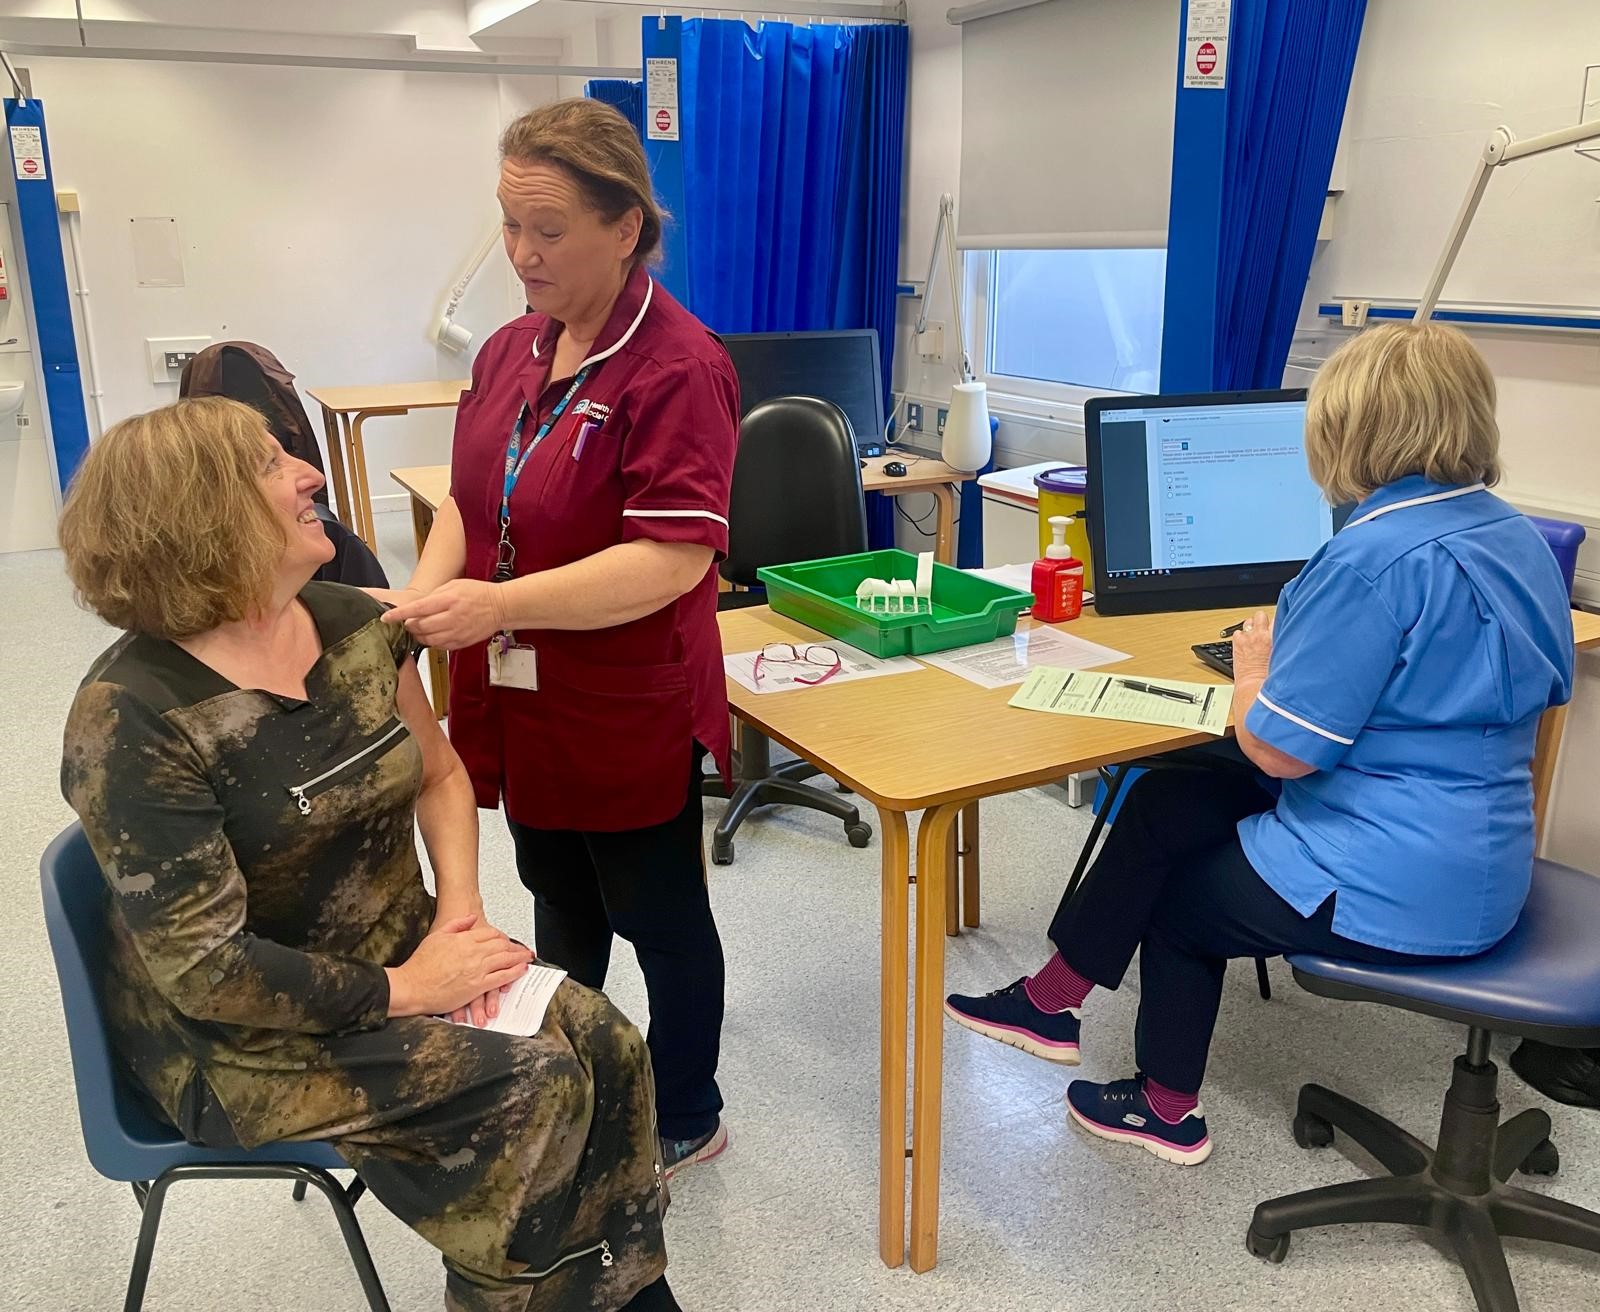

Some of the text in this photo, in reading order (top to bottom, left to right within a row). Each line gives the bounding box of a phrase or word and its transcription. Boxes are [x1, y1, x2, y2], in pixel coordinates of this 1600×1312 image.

[565, 381, 580, 400] NHS
[588, 410, 604, 420] ocial
[589, 402, 610, 414] Health
[510, 430, 521, 450] NHS
